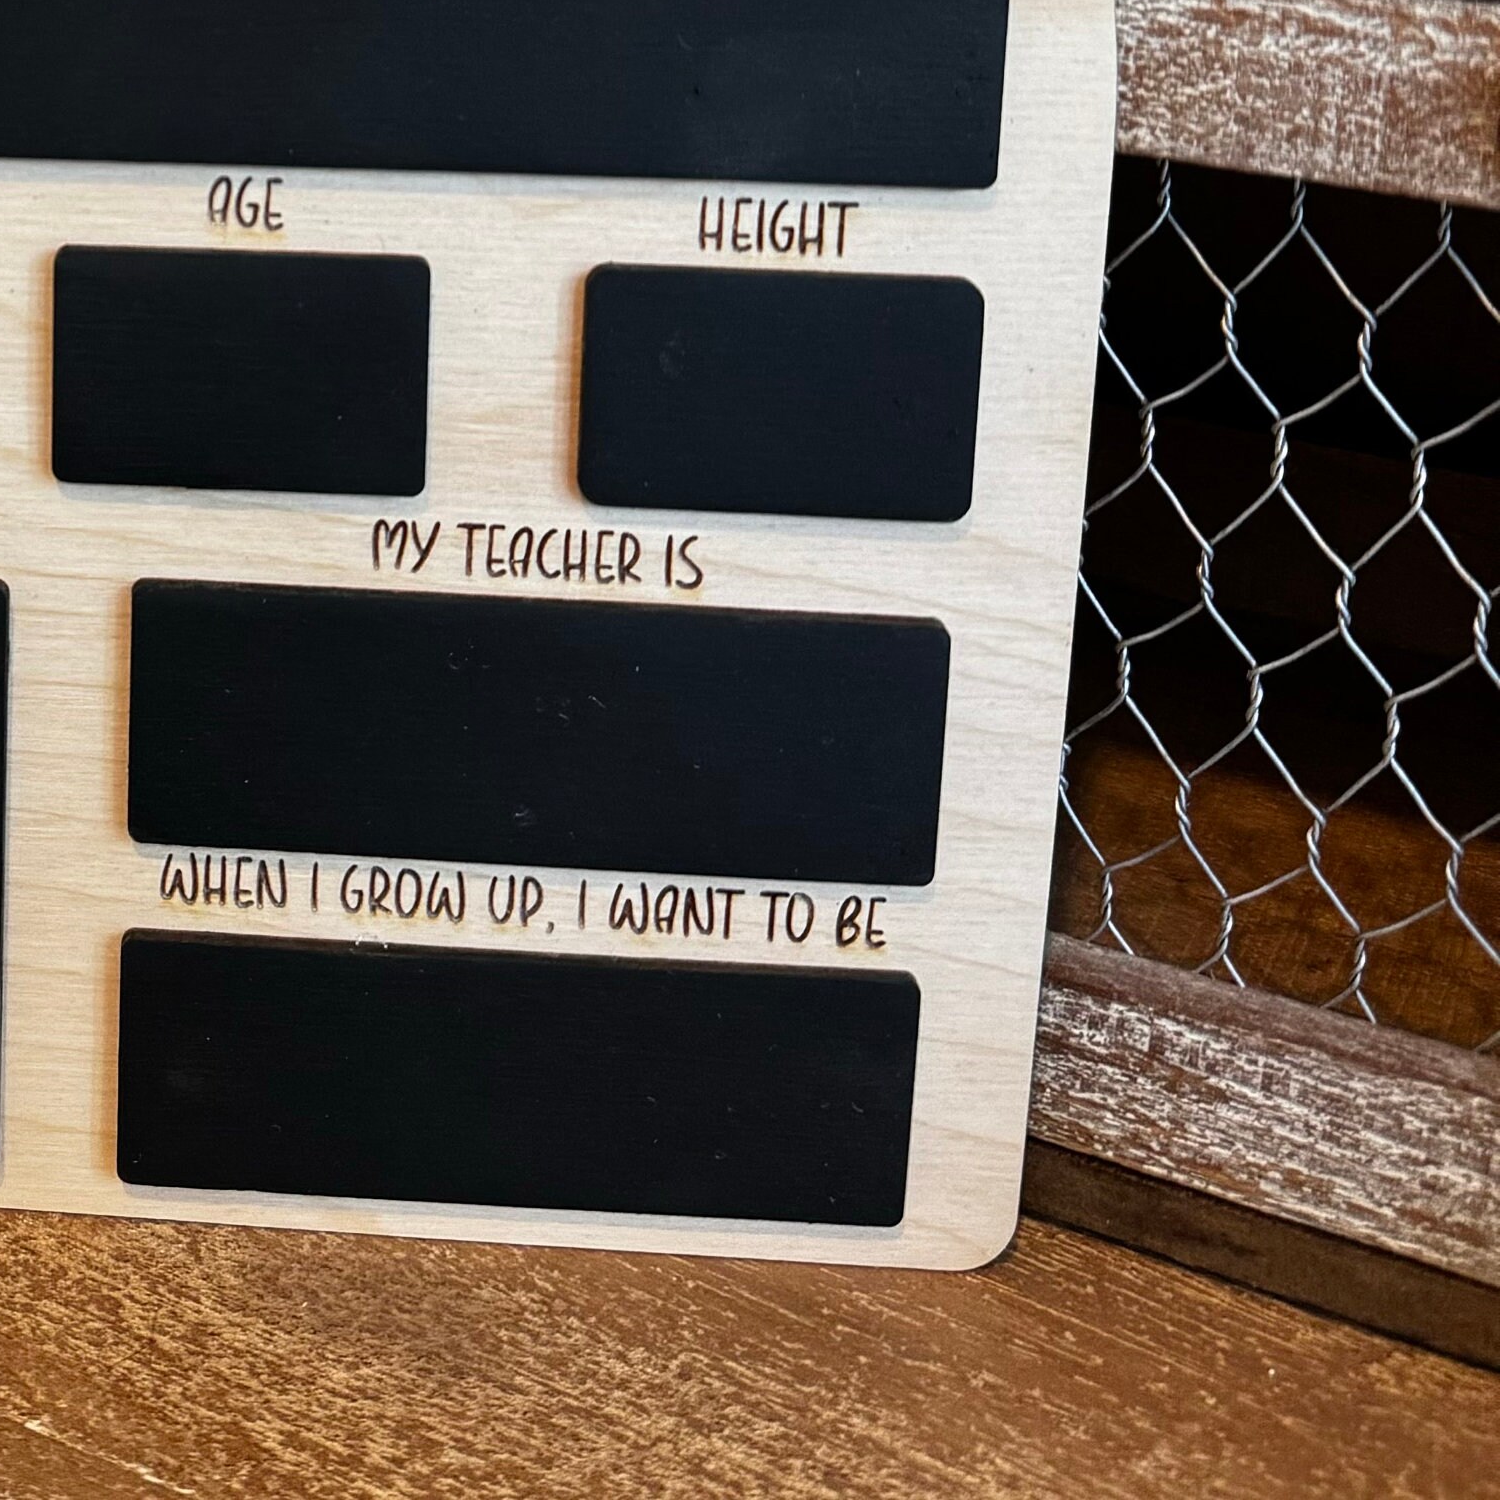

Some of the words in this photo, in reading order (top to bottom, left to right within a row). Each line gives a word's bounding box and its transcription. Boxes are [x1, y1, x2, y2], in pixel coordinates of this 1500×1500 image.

[206, 175, 286, 232] AGE
[697, 196, 860, 259] HEIGHT
[371, 518, 441, 574] MY
[456, 521, 643, 586] TEACHER
[663, 533, 704, 591] IS
[159, 853, 288, 911] WHEN
[310, 861, 320, 913] I
[339, 864, 468, 925] GROW
[487, 876, 556, 935] UP,
[577, 878, 587, 930] I
[608, 885, 746, 940] WANT
[760, 889, 815, 944] TO
[835, 896, 889, 949] BE
